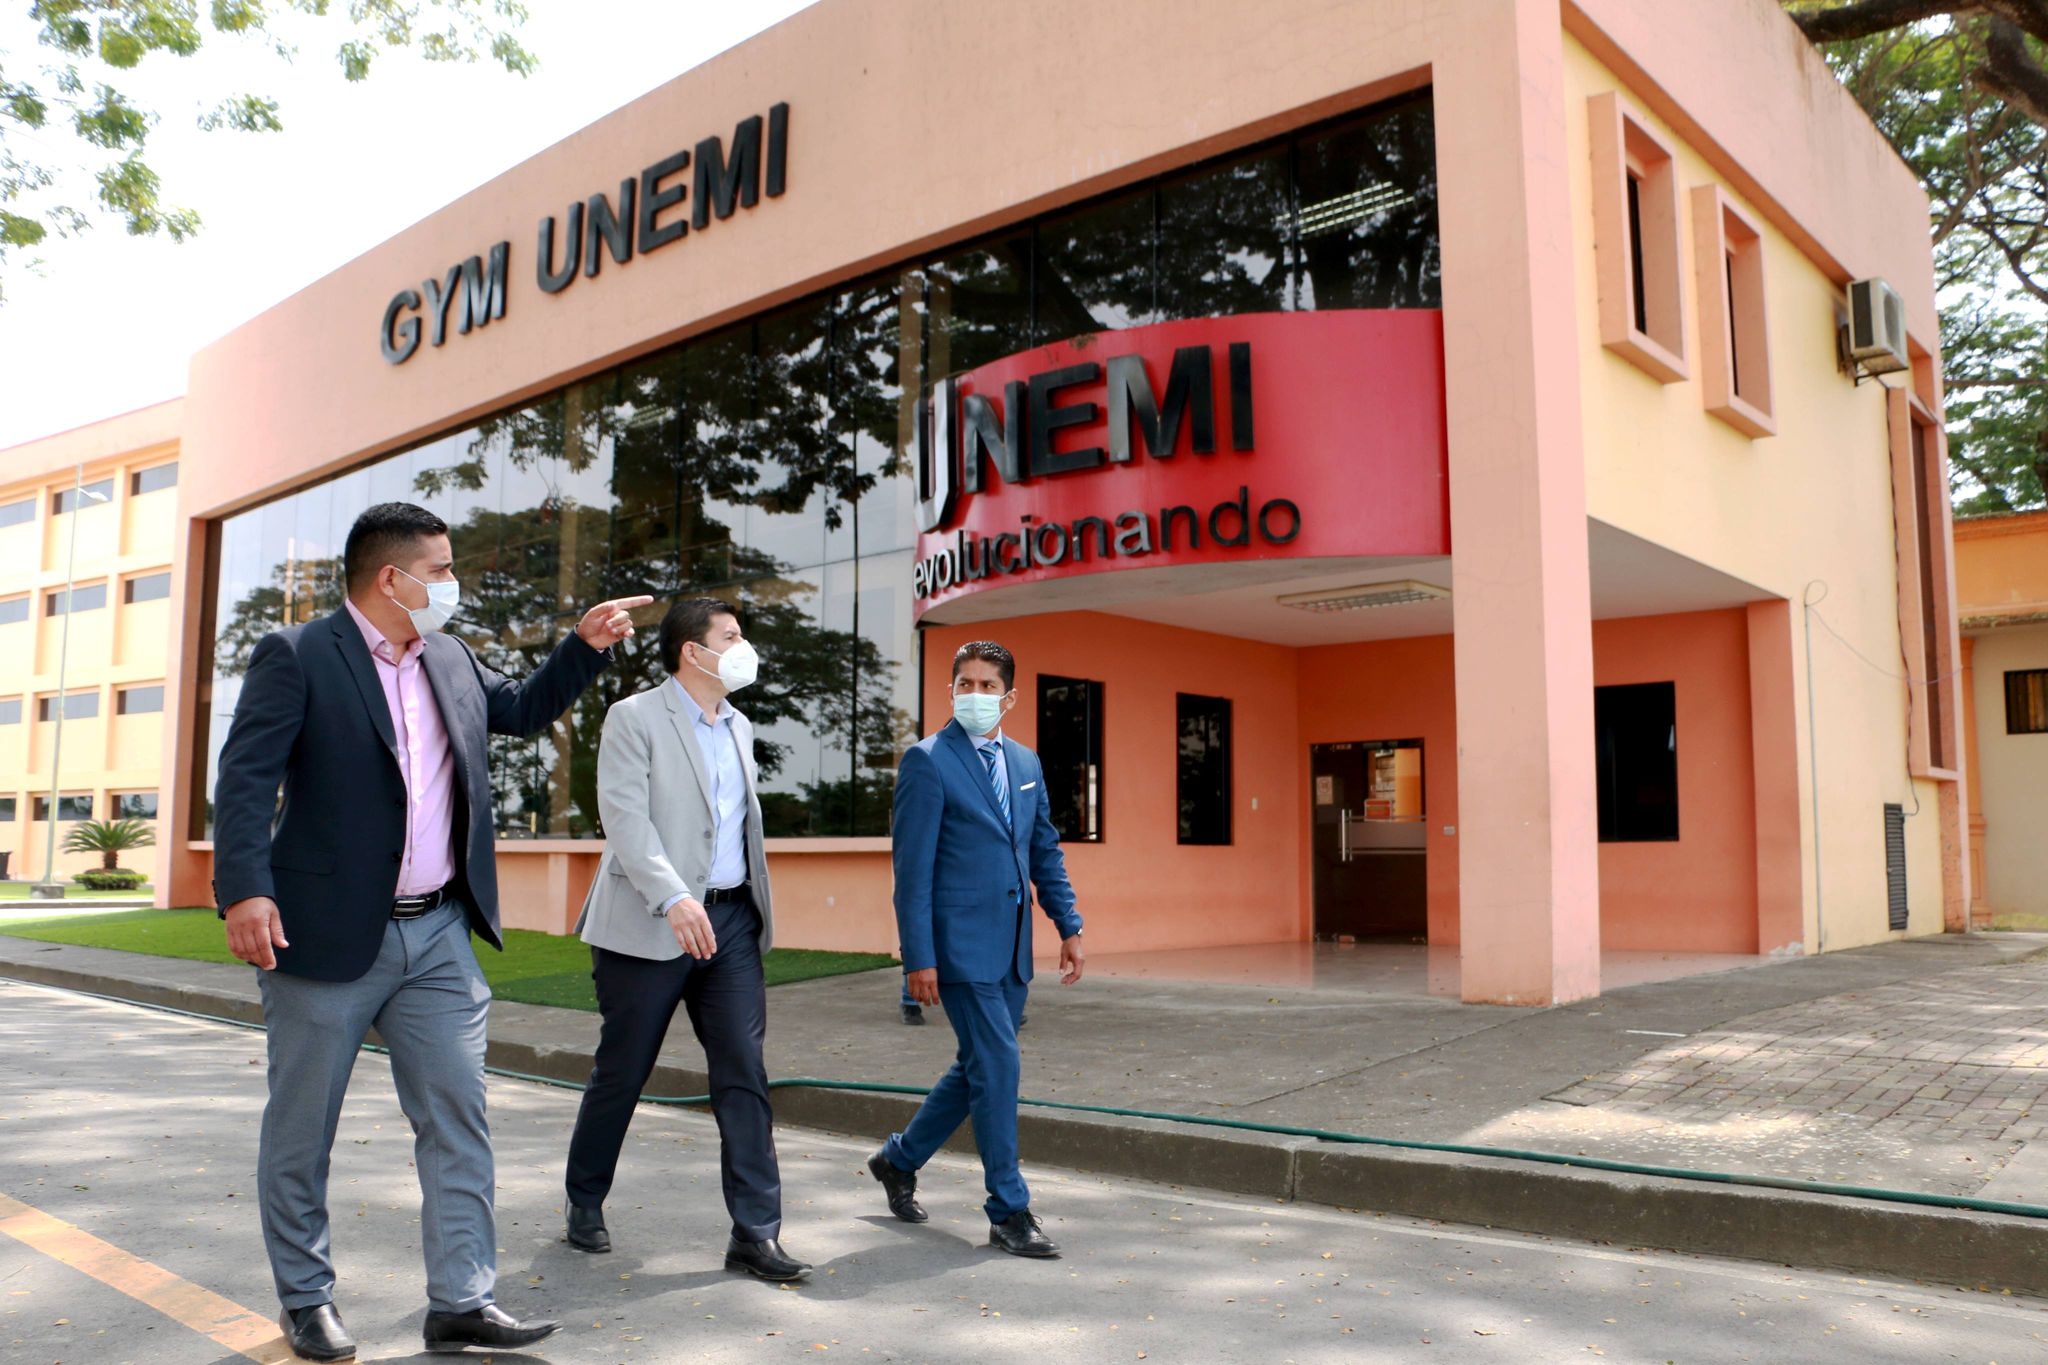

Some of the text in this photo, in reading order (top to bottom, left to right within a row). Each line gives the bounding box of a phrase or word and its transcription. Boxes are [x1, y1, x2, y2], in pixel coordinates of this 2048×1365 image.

[380, 101, 789, 365] GYM UNEMI
[913, 342, 1255, 534] UNEMI
[913, 485, 1301, 600] evolucionando
